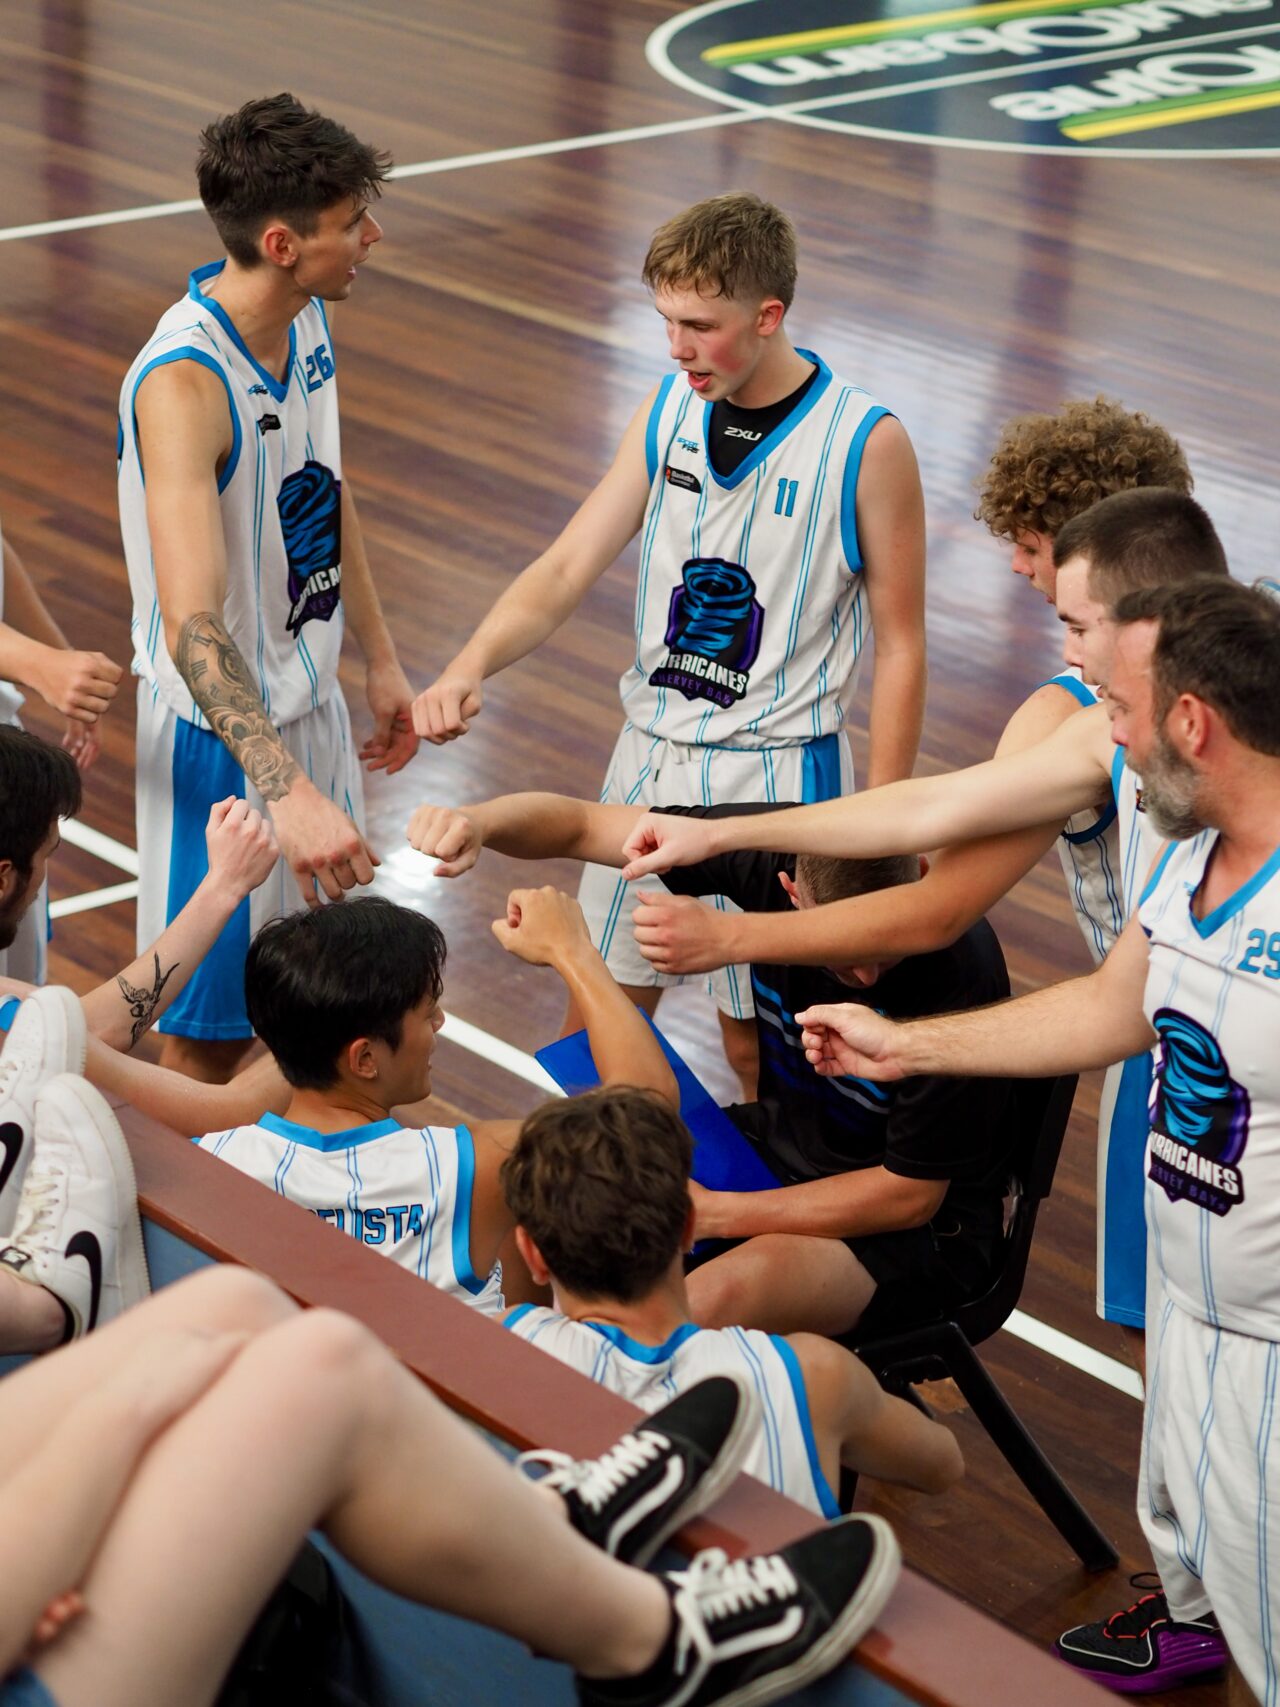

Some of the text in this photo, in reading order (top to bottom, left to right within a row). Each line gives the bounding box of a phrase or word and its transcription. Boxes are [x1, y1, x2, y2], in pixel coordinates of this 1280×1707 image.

[305, 343, 335, 394] 26
[723, 426, 763, 442] 2XU
[774, 477, 799, 518] 11
